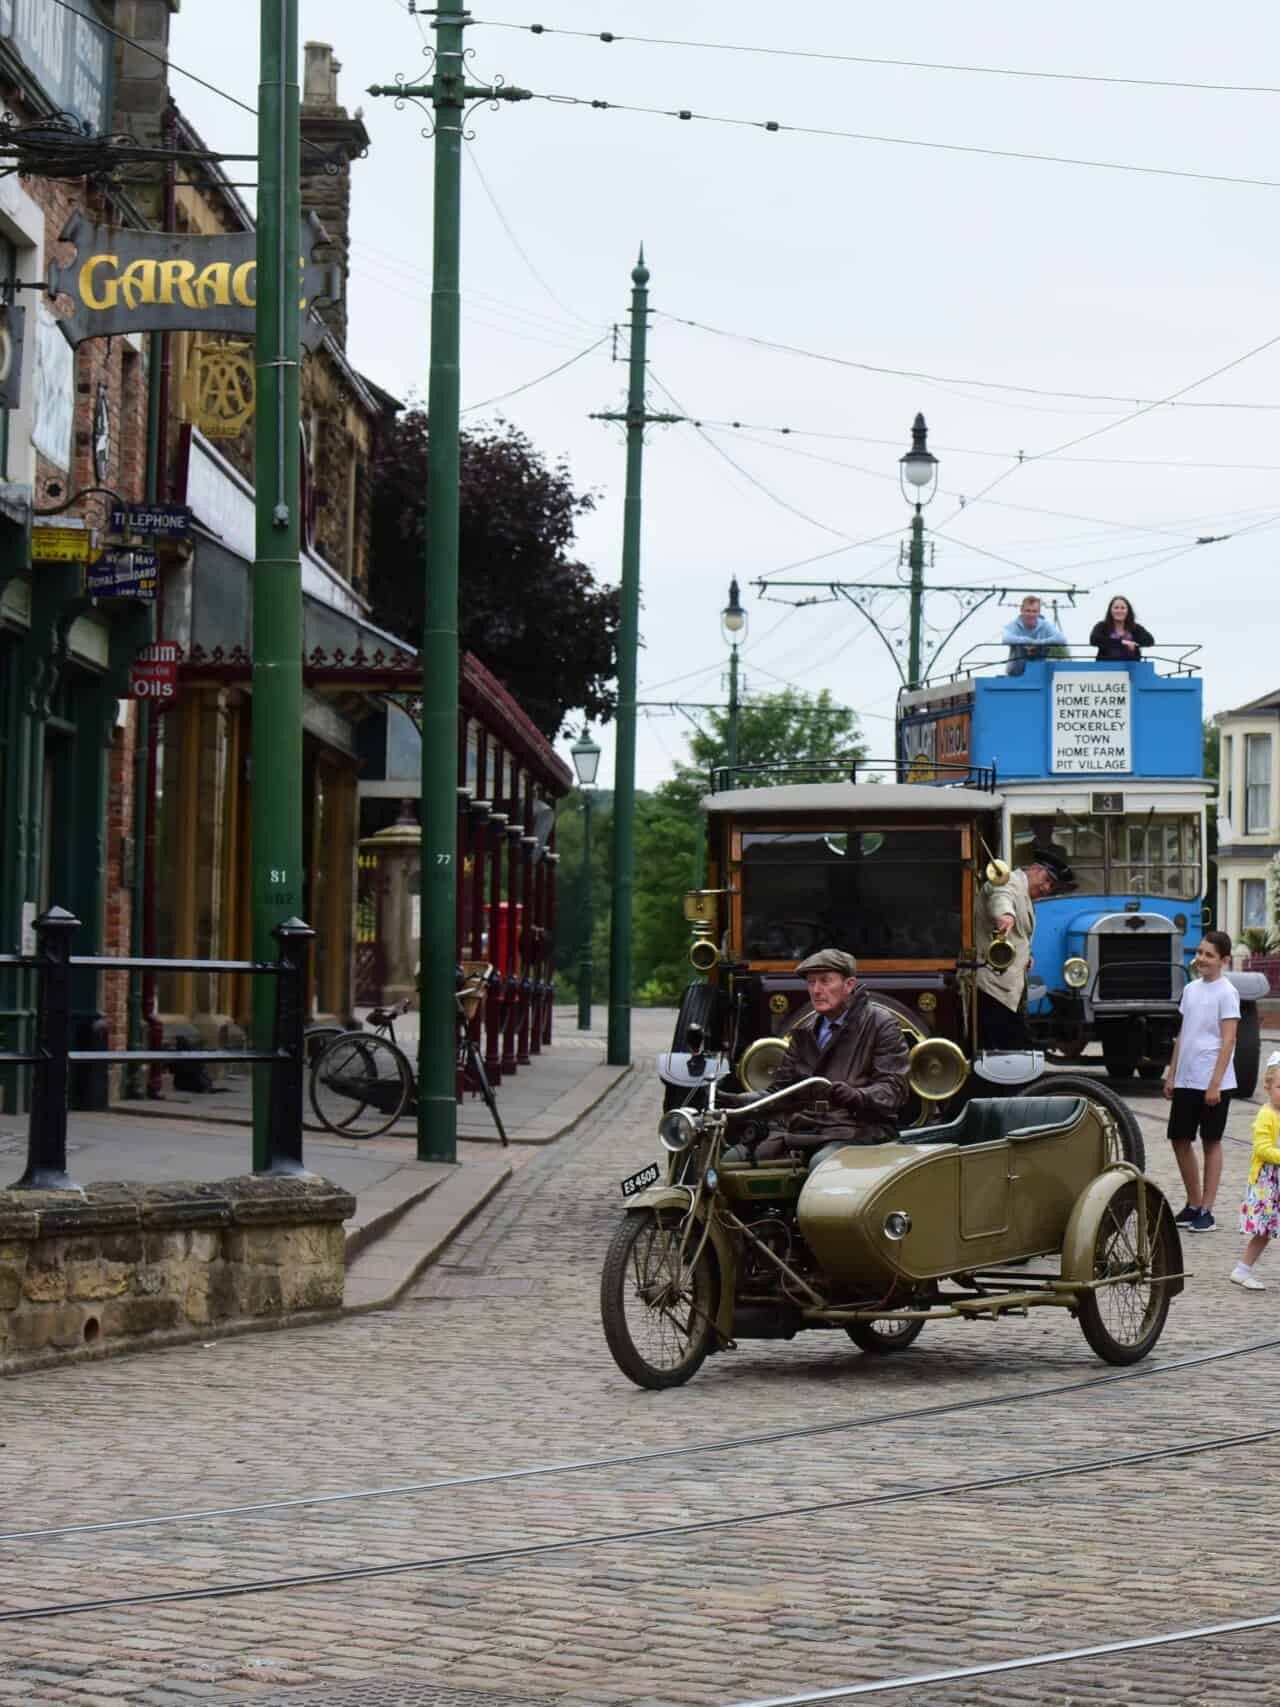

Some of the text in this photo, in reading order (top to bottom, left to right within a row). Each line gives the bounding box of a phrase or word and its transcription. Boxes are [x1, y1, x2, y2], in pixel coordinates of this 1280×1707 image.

[78, 255, 305, 310] GARAG
[135, 680, 174, 696] Oils
[1056, 683, 1128, 693] PIT VILLAGE
[1056, 696, 1126, 706] HOME FARM
[1059, 709, 1121, 719] ENTRANCE
[1056, 722, 1125, 731] POCKERLEY
[1074, 735, 1110, 744] TOWN
[1057, 747, 1125, 757] HOME FARM
[1056, 760, 1127, 769] PIT VILLAGE
[436, 853, 451, 865] 77
[624, 1167, 657, 1194] ES 4509
